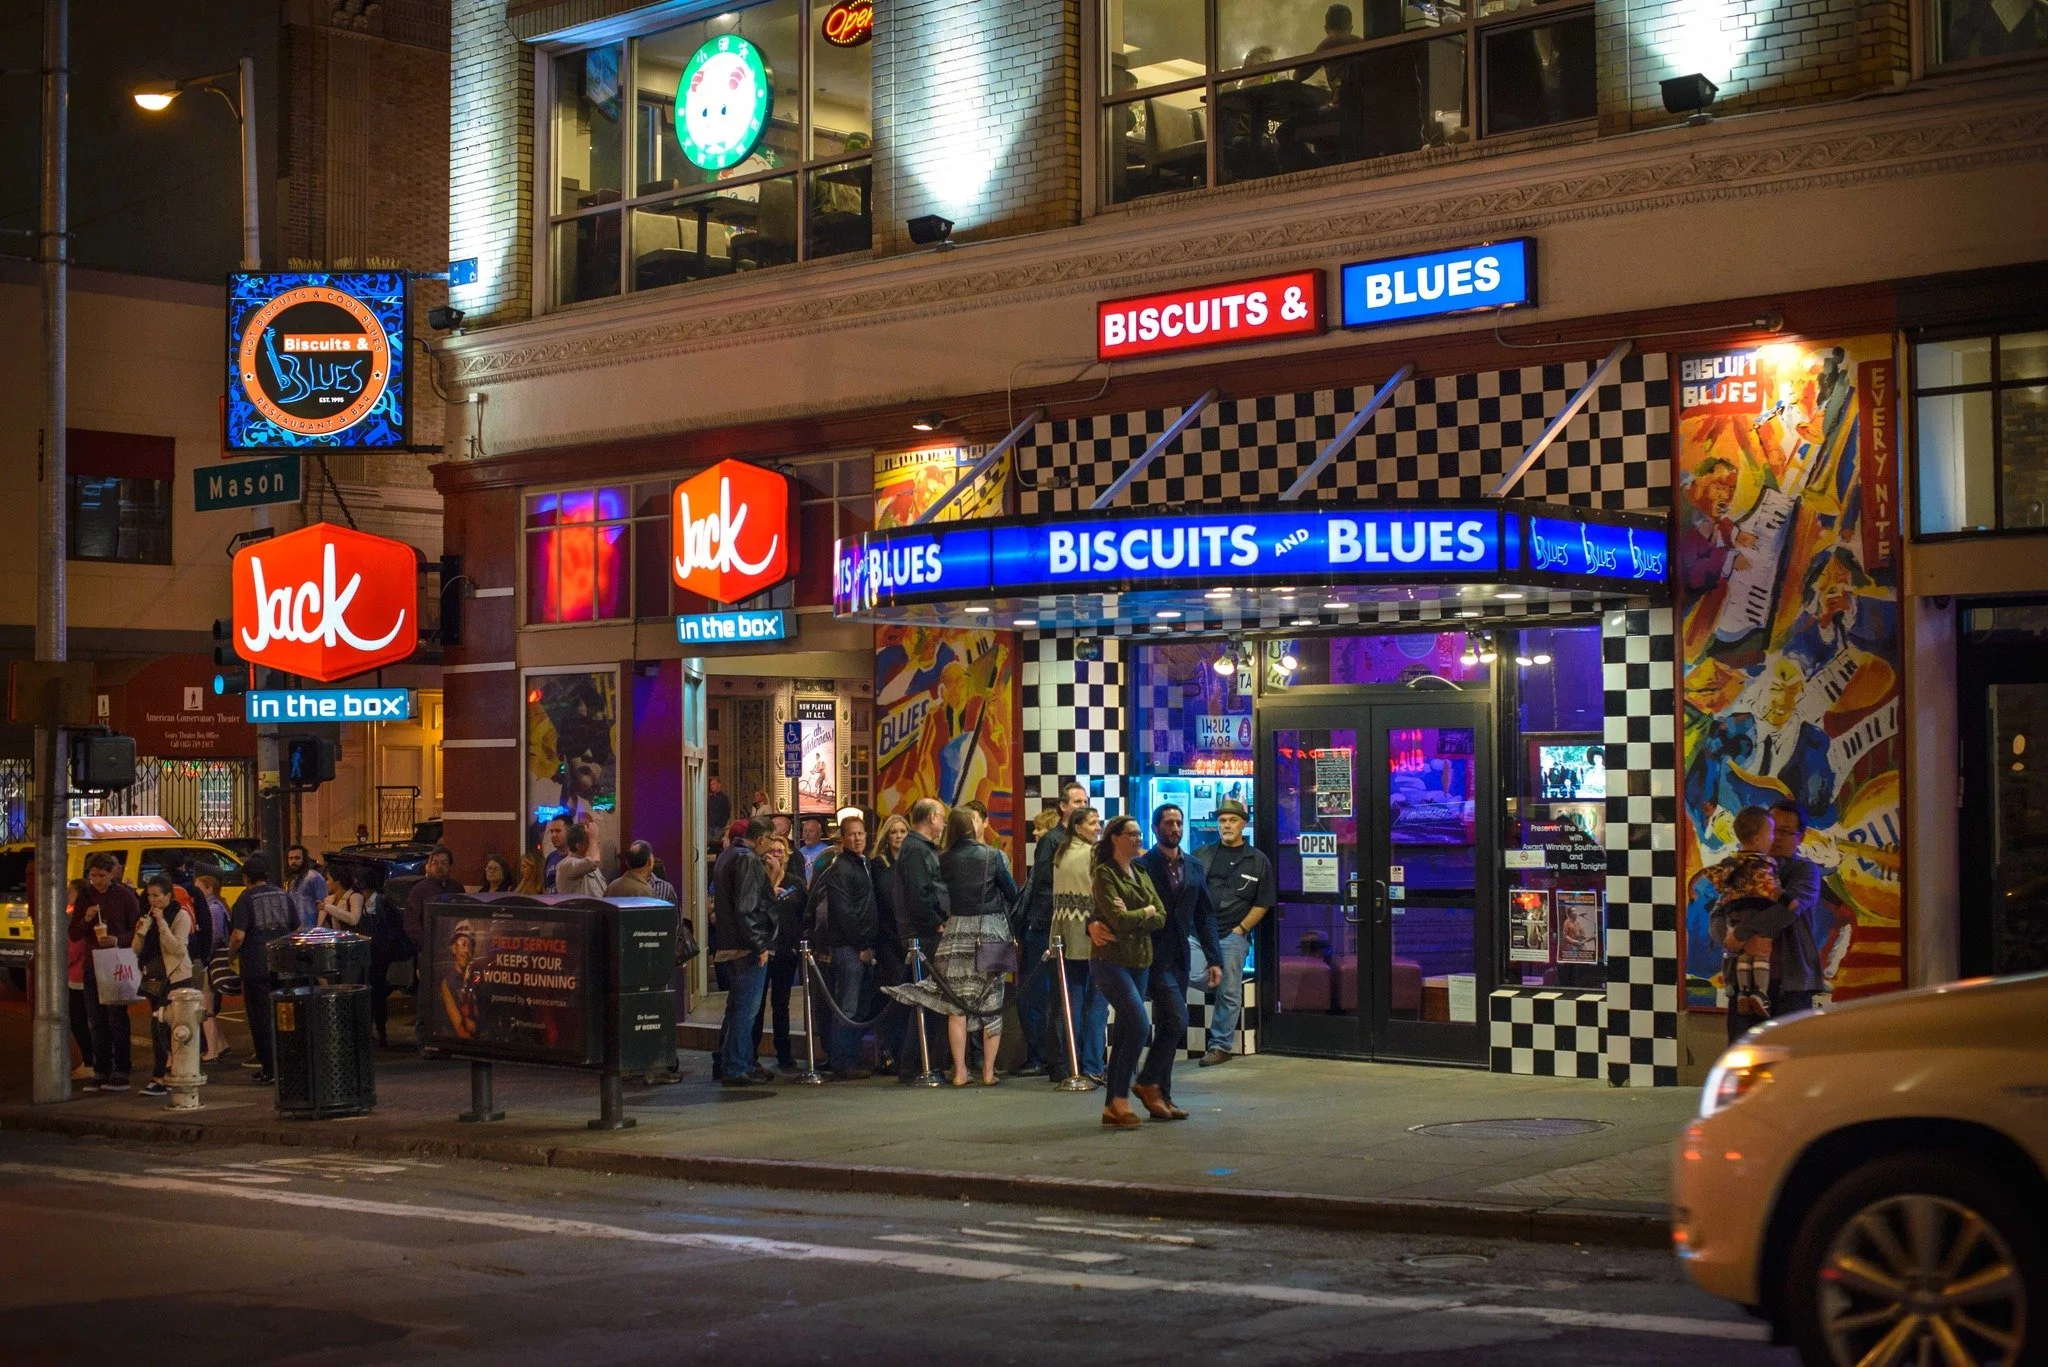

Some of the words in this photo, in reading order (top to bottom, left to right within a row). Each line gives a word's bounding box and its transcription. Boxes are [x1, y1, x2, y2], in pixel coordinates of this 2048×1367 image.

[1365, 255, 1501, 310] BLUES
[244, 331, 258, 357] HOT
[255, 290, 308, 327] BISCUITS
[313, 290, 321, 299] &
[327, 292, 360, 314] COOL
[361, 314, 384, 353] BLUES
[1103, 291, 1269, 347] BISCUITS
[1280, 285, 1308, 320] &
[283, 337, 351, 351] Biscuits
[356, 337, 369, 351] &
[1682, 380, 1758, 409] BLUES
[256, 397, 333, 431] RESTAURANT
[339, 415, 347, 423] &
[350, 395, 371, 416] BAR
[1871, 367, 1889, 477] EVERY
[208, 472, 284, 500] Mason
[675, 476, 778, 579] Jack
[1875, 483, 1891, 560] NITE
[1048, 524, 1260, 574] BISCUITS
[1274, 527, 1310, 558] AND
[1327, 518, 1487, 564] BLUES
[869, 543, 943, 590] BLUES
[241, 543, 405, 652] Jack
[680, 617, 699, 640] in
[701, 616, 736, 639] the
[737, 614, 777, 638] box
[252, 694, 279, 718] in
[286, 694, 337, 718] the
[343, 694, 401, 717] box
[805, 711, 812, 719] AT
[811, 703, 833, 711] PLAYING
[145, 712, 175, 722] American
[176, 712, 215, 726] Conservatory
[216, 712, 241, 723] Theater
[104, 822, 167, 833] Percolate
[1530, 824, 1562, 832] Preservin'
[1564, 824, 1576, 832] the
[1301, 835, 1335, 853] OPEN
[1522, 843, 1544, 851] Award
[1545, 843, 1573, 852] Winning
[1574, 843, 1605, 851] Southern
[1545, 862, 1559, 870] Live
[1560, 862, 1579, 870] Blues
[492, 935, 521, 950] FIELD
[522, 937, 568, 954] SERVICE
[113, 964, 134, 982] H&M
[496, 953, 530, 970] KEEPS
[531, 954, 562, 972] YOUR
[483, 970, 521, 987] WORLD
[523, 972, 577, 991] RUNNING
[491, 994, 517, 1003] powered
[517, 994, 525, 1006] by
